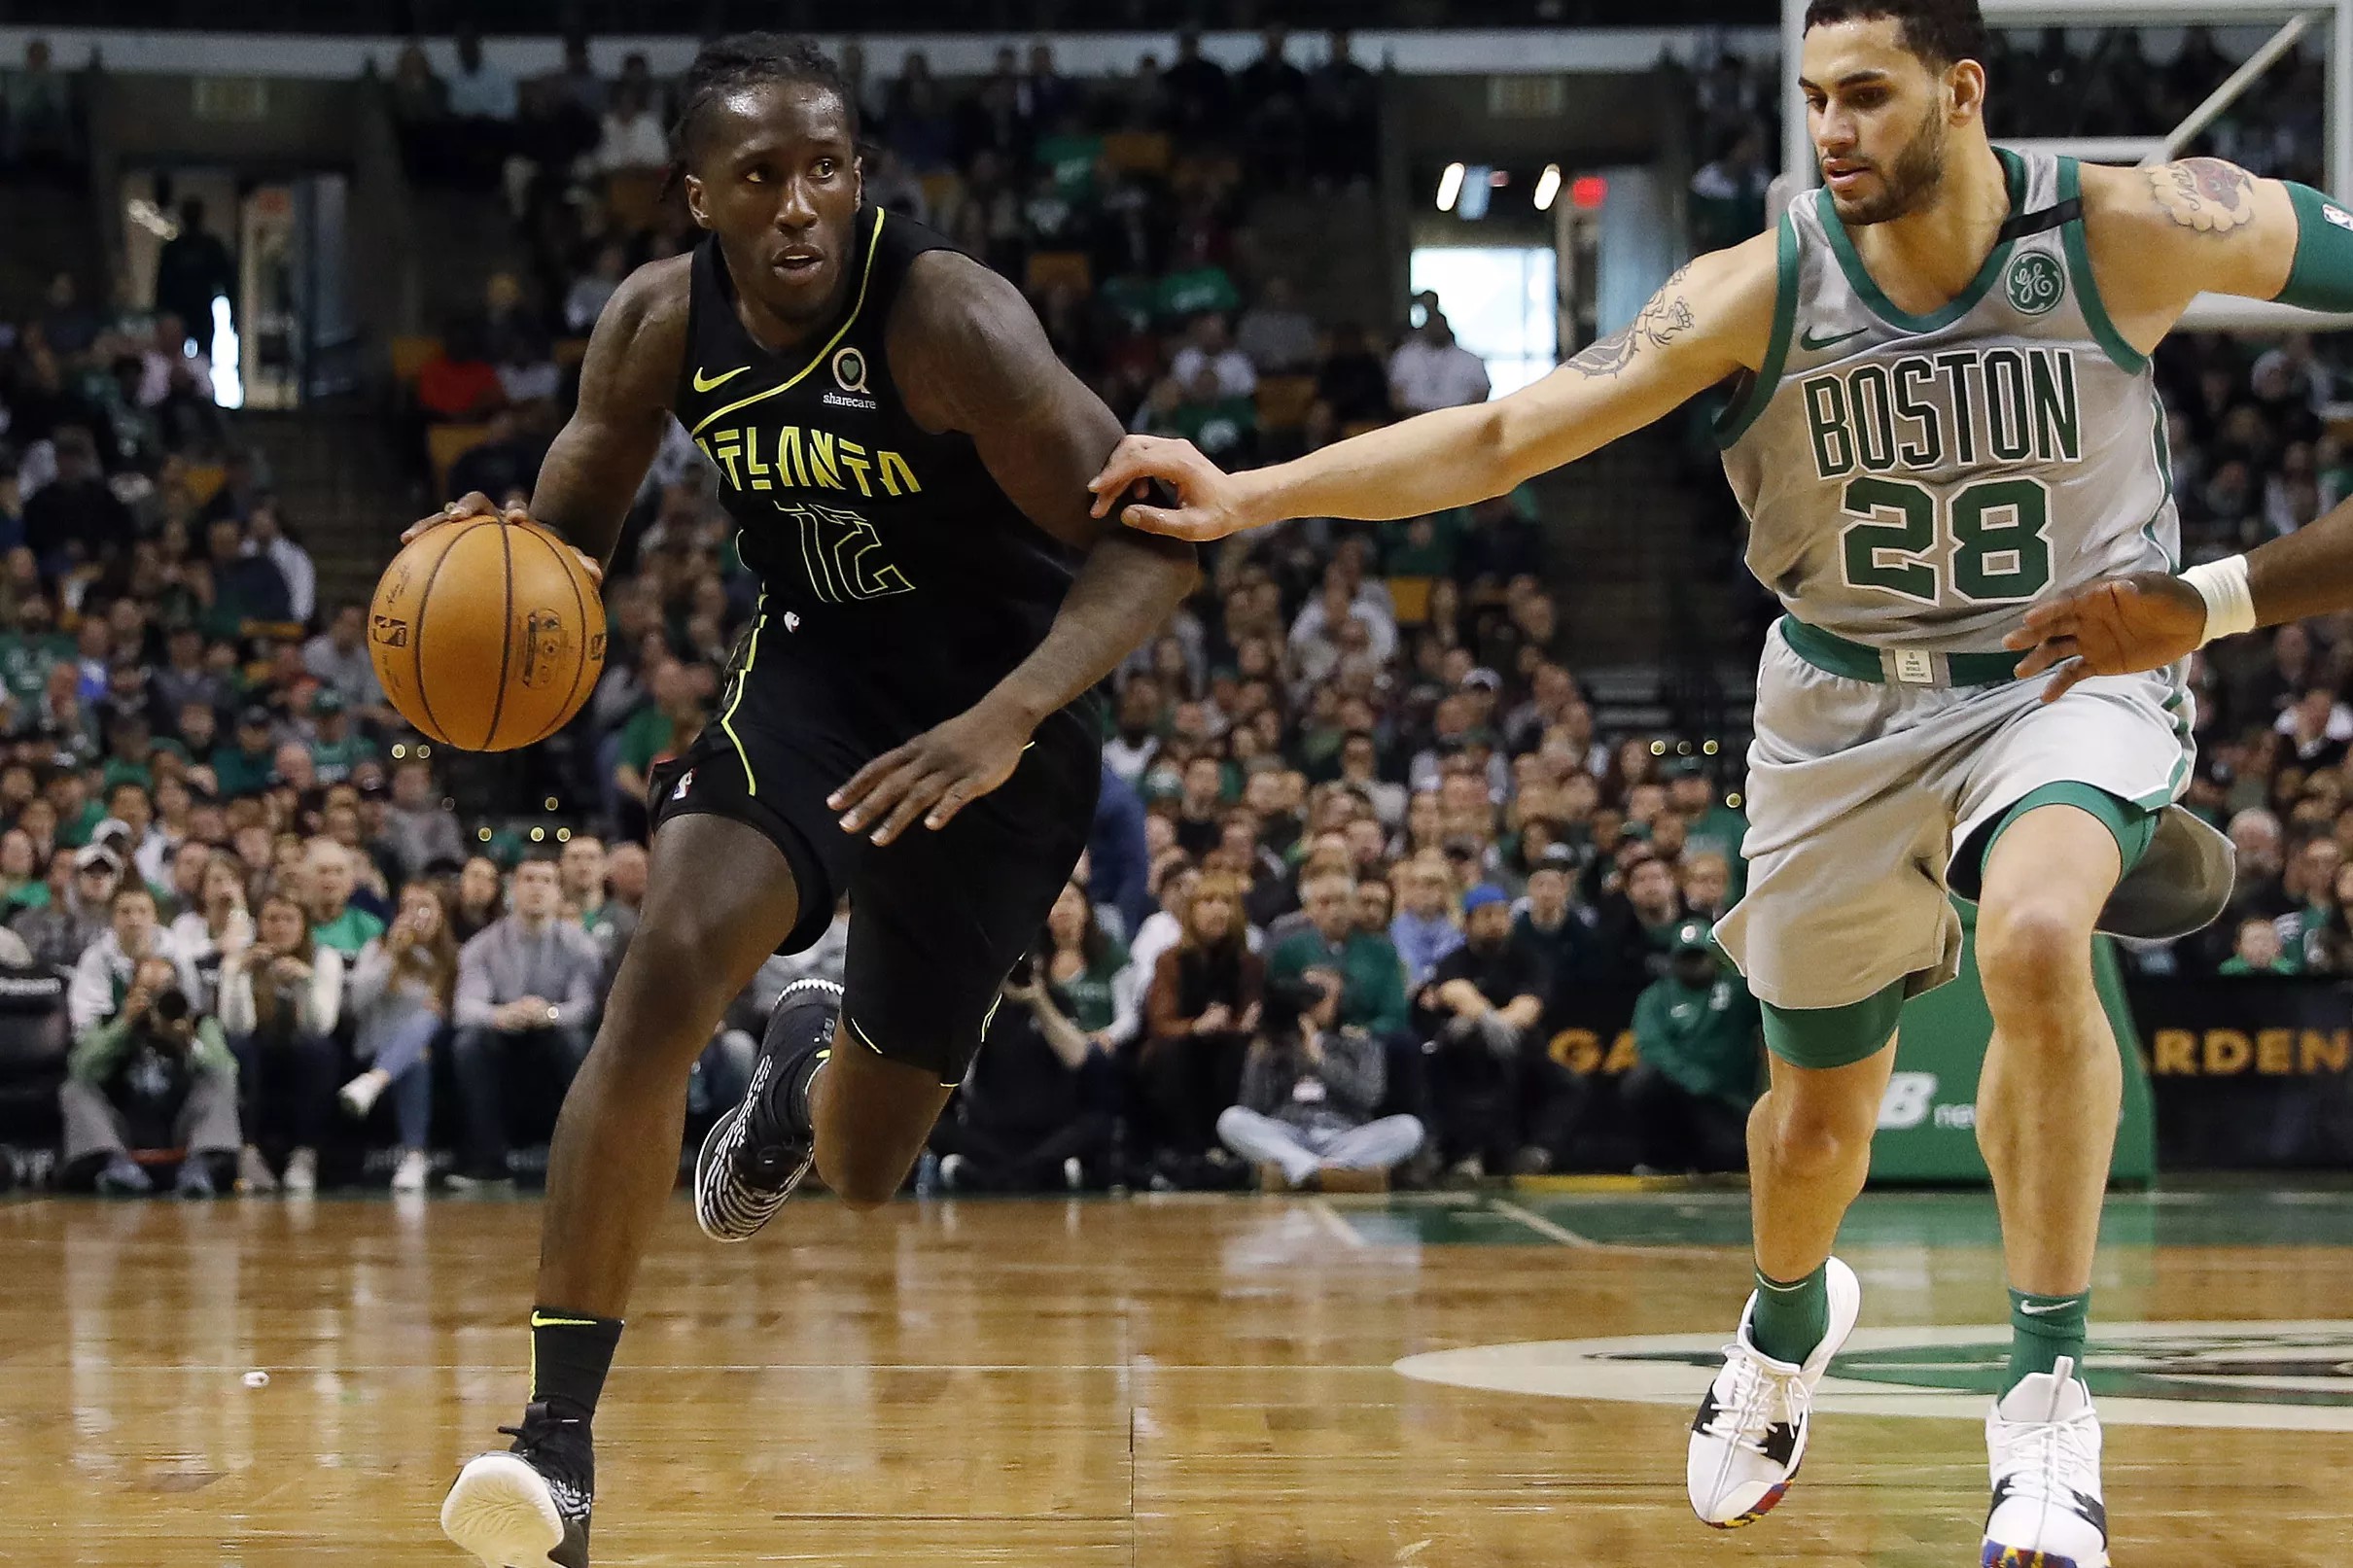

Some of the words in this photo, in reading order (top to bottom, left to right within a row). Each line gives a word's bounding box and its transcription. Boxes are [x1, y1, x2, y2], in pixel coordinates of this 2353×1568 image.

[823, 392, 877, 409] sharecare
[1801, 347, 2083, 481] BOSTON
[774, 499, 917, 604] 12
[1838, 474, 2055, 608] 28
[2154, 1027, 2351, 1075] RDEN
